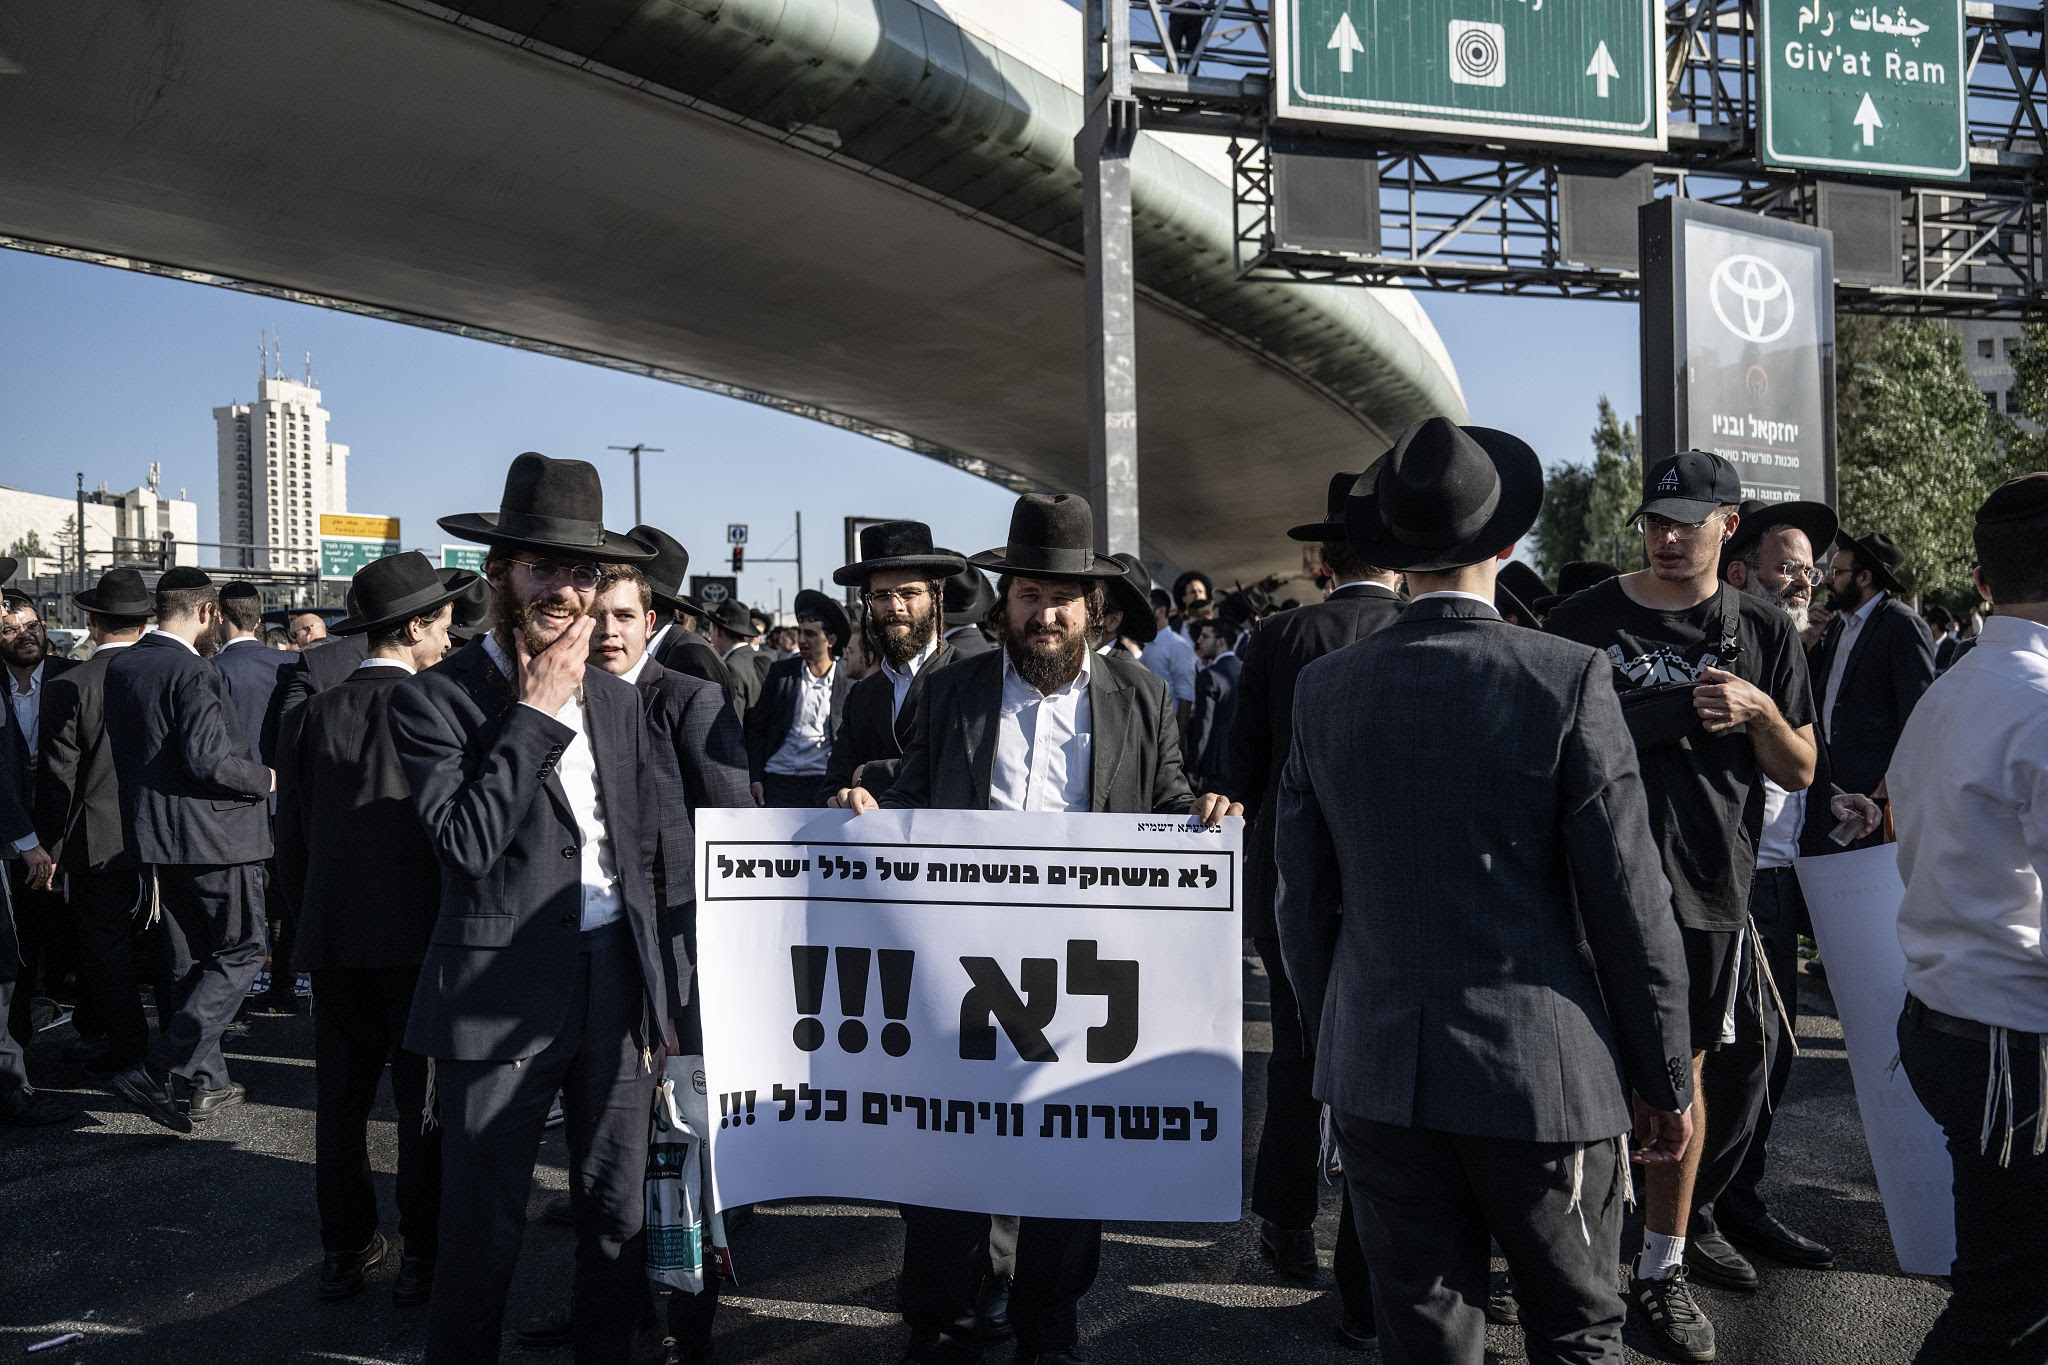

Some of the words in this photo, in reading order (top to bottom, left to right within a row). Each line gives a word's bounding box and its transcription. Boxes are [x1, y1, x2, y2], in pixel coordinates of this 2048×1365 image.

[1798, 0, 1835, 37] رام
[1785, 41, 1872, 77] Giv'at
[1885, 52, 1945, 85] Ram
[1712, 413, 1745, 437] ובניו
[1748, 413, 1799, 446] יחזקאל
[1741, 450, 1773, 465] מורשית
[1774, 454, 1800, 468] סוכנות
[1136, 821, 1174, 832] דשמיא
[717, 854, 811, 879] ישראל
[817, 854, 868, 881] כלל
[875, 856, 920, 882] של
[926, 862, 1040, 885] בנשמות
[1047, 865, 1170, 890] משחקים
[1177, 864, 1218, 889] לא
[790, 945, 916, 1058] !!!
[958, 939, 1140, 1064] לא
[720, 1089, 757, 1130] !!!
[772, 1082, 848, 1122] כלל
[862, 1091, 1025, 1138] וויתורים
[1039, 1100, 1218, 1142] לפשרות
